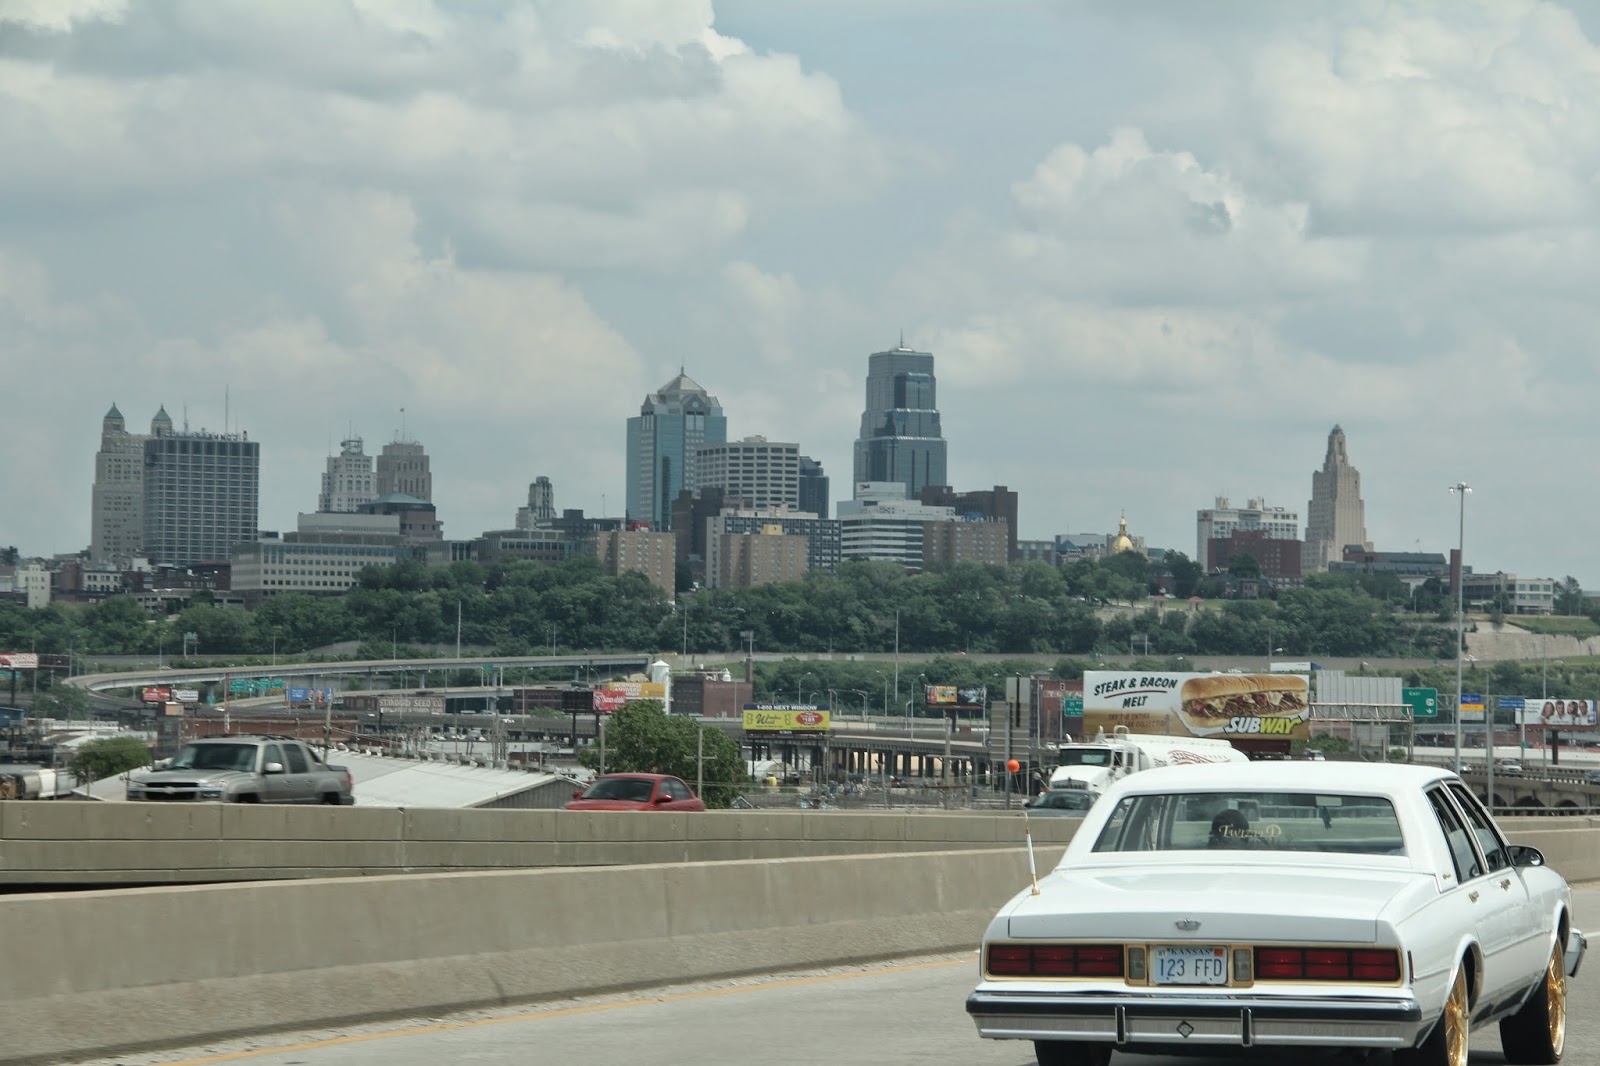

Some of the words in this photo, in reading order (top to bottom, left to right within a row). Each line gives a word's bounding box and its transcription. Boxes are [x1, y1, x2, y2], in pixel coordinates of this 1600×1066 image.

[1094, 679, 1127, 696] STEAK
[1128, 678, 1137, 688] &
[1140, 677, 1178, 689] BACON
[414, 699, 431, 708] SEED
[1122, 696, 1149, 709] MELT
[1226, 716, 1303, 735] SUBWAY
[1171, 948, 1211, 956] KANSAS
[1160, 958, 1185, 977] 123
[1195, 958, 1222, 977] FFD
